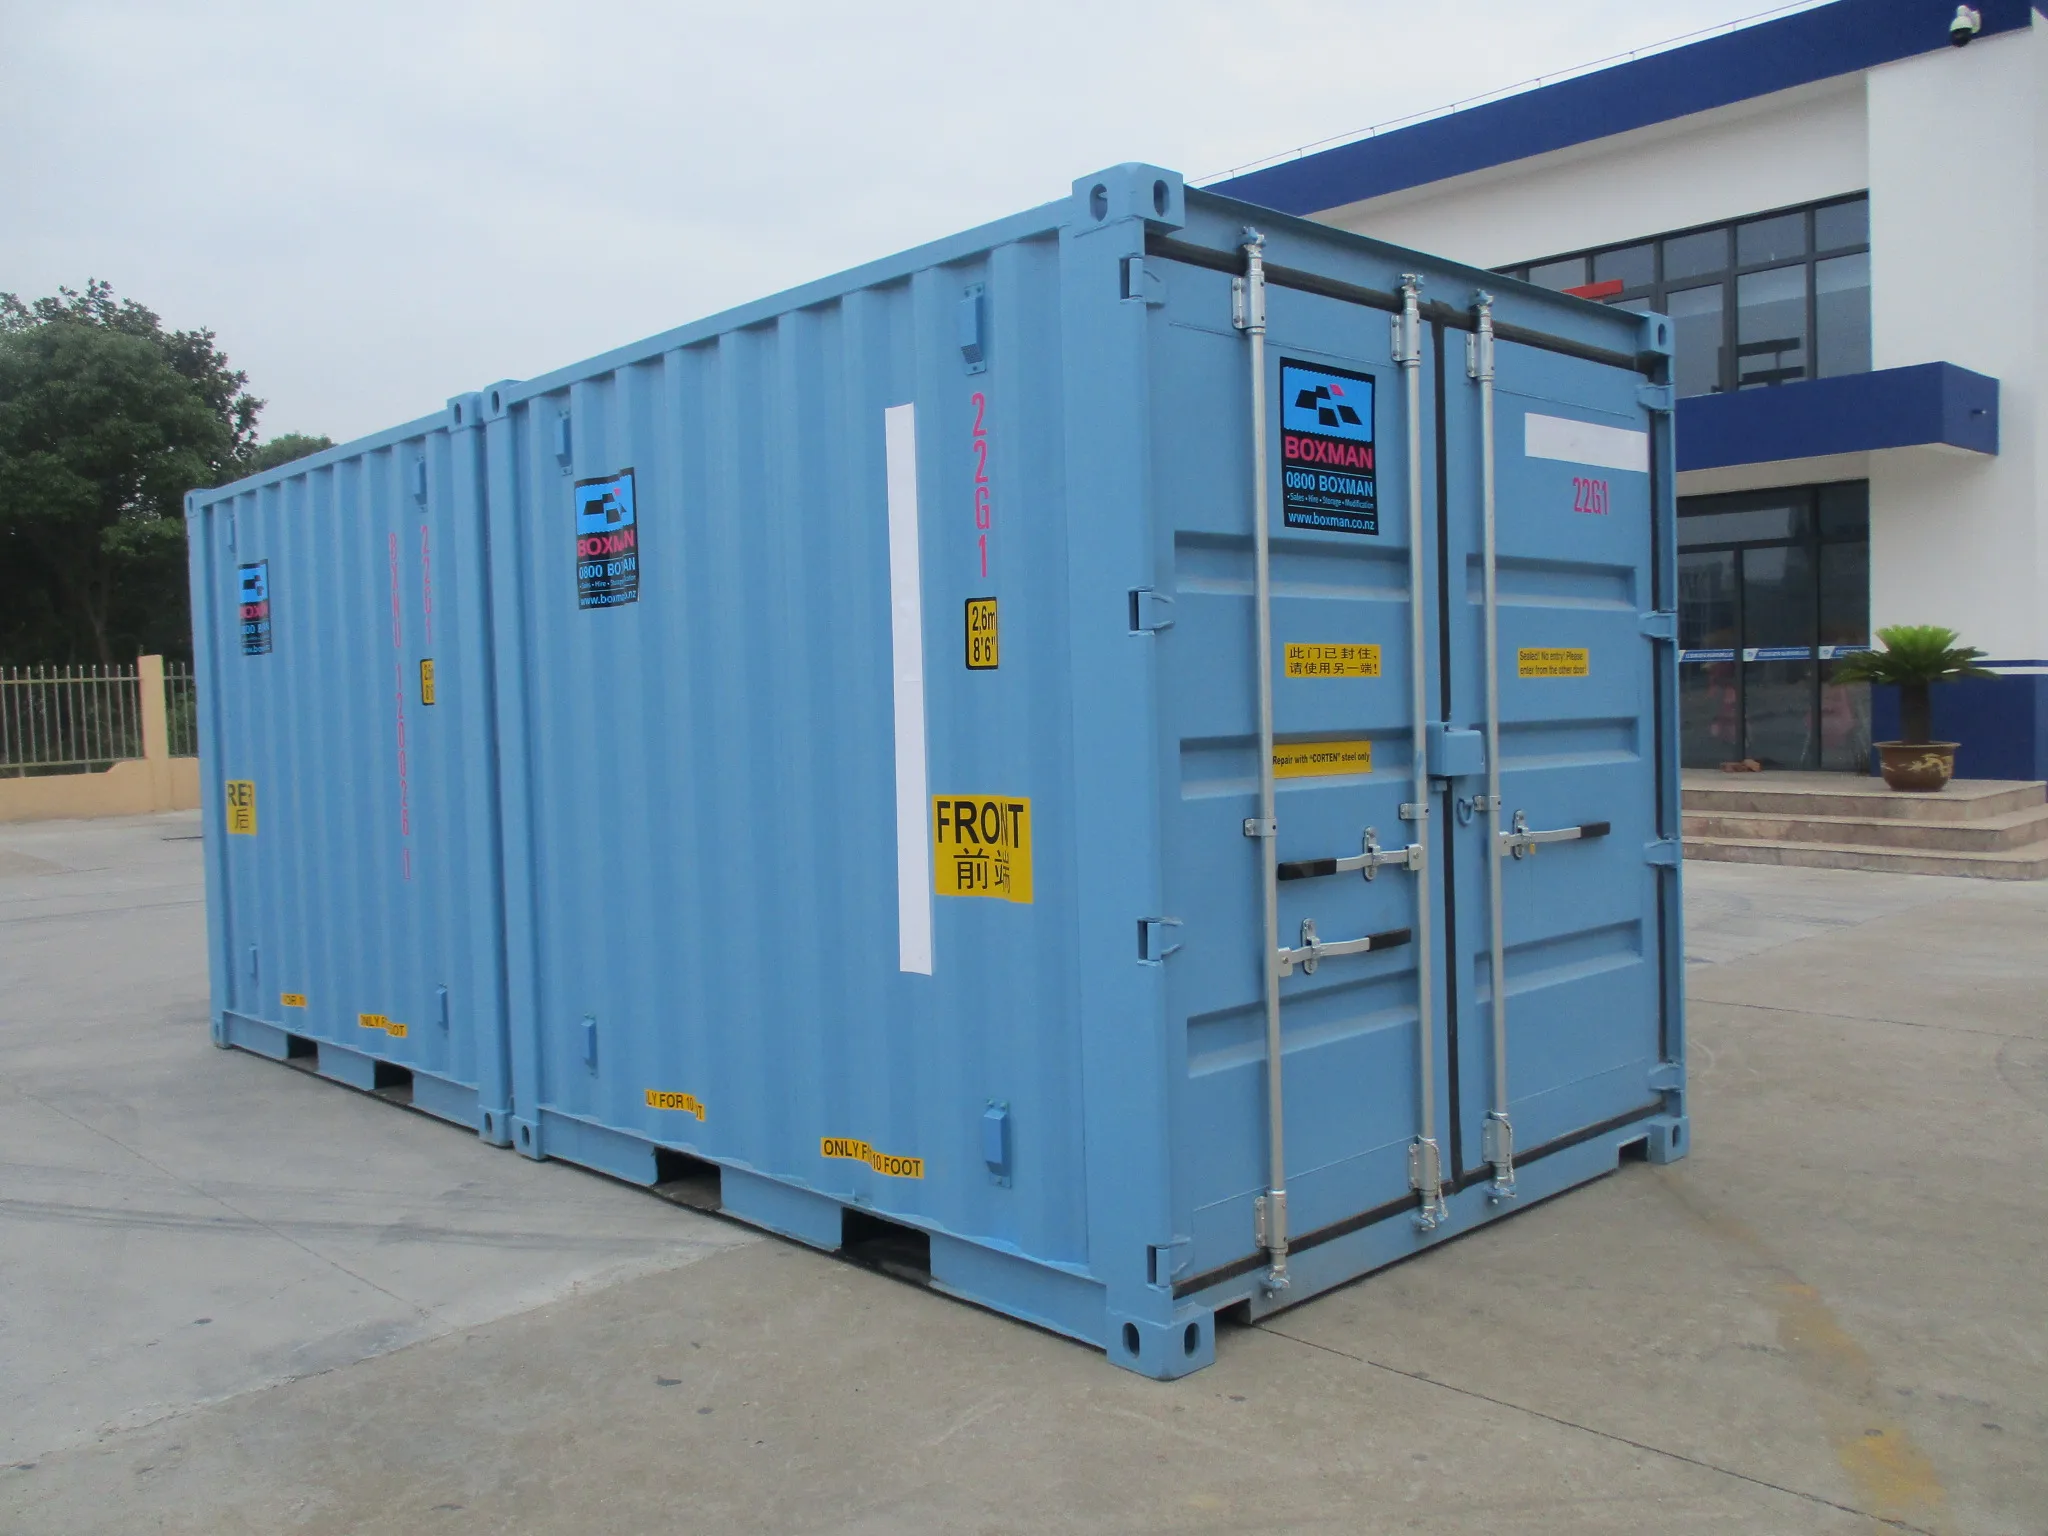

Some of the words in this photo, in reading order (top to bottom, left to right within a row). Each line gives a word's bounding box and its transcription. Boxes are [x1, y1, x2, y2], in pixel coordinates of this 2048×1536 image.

[1284, 436, 1373, 470] BOXMAN
[971, 392, 991, 578] 22G1
[1286, 471, 1315, 490] 0800
[1319, 476, 1374, 498] BOXMAN
[1572, 477, 1609, 515] 22G1
[1290, 492, 1304, 502] Sales
[1308, 494, 1319, 504] Hire
[1322, 495, 1342, 507] Storage
[1344, 498, 1374, 510] Modification
[1288, 511, 1375, 531] www.boxman.co.nz
[579, 565, 603, 579] 0800
[607, 557, 636, 577] BOAN
[1289, 662, 1377, 675] 请使用另一端!
[1272, 755, 1293, 767] Repair
[1295, 754, 1308, 764] with
[1341, 752, 1356, 762] steel
[1357, 752, 1370, 763] only
[936, 801, 1024, 849] FRONT
[659, 1093, 684, 1110] FOR
[686, 1096, 694, 1112] 10
[823, 1139, 859, 1158] ONLY
[872, 1153, 882, 1171] 10
[884, 1157, 921, 1177] FOOT
